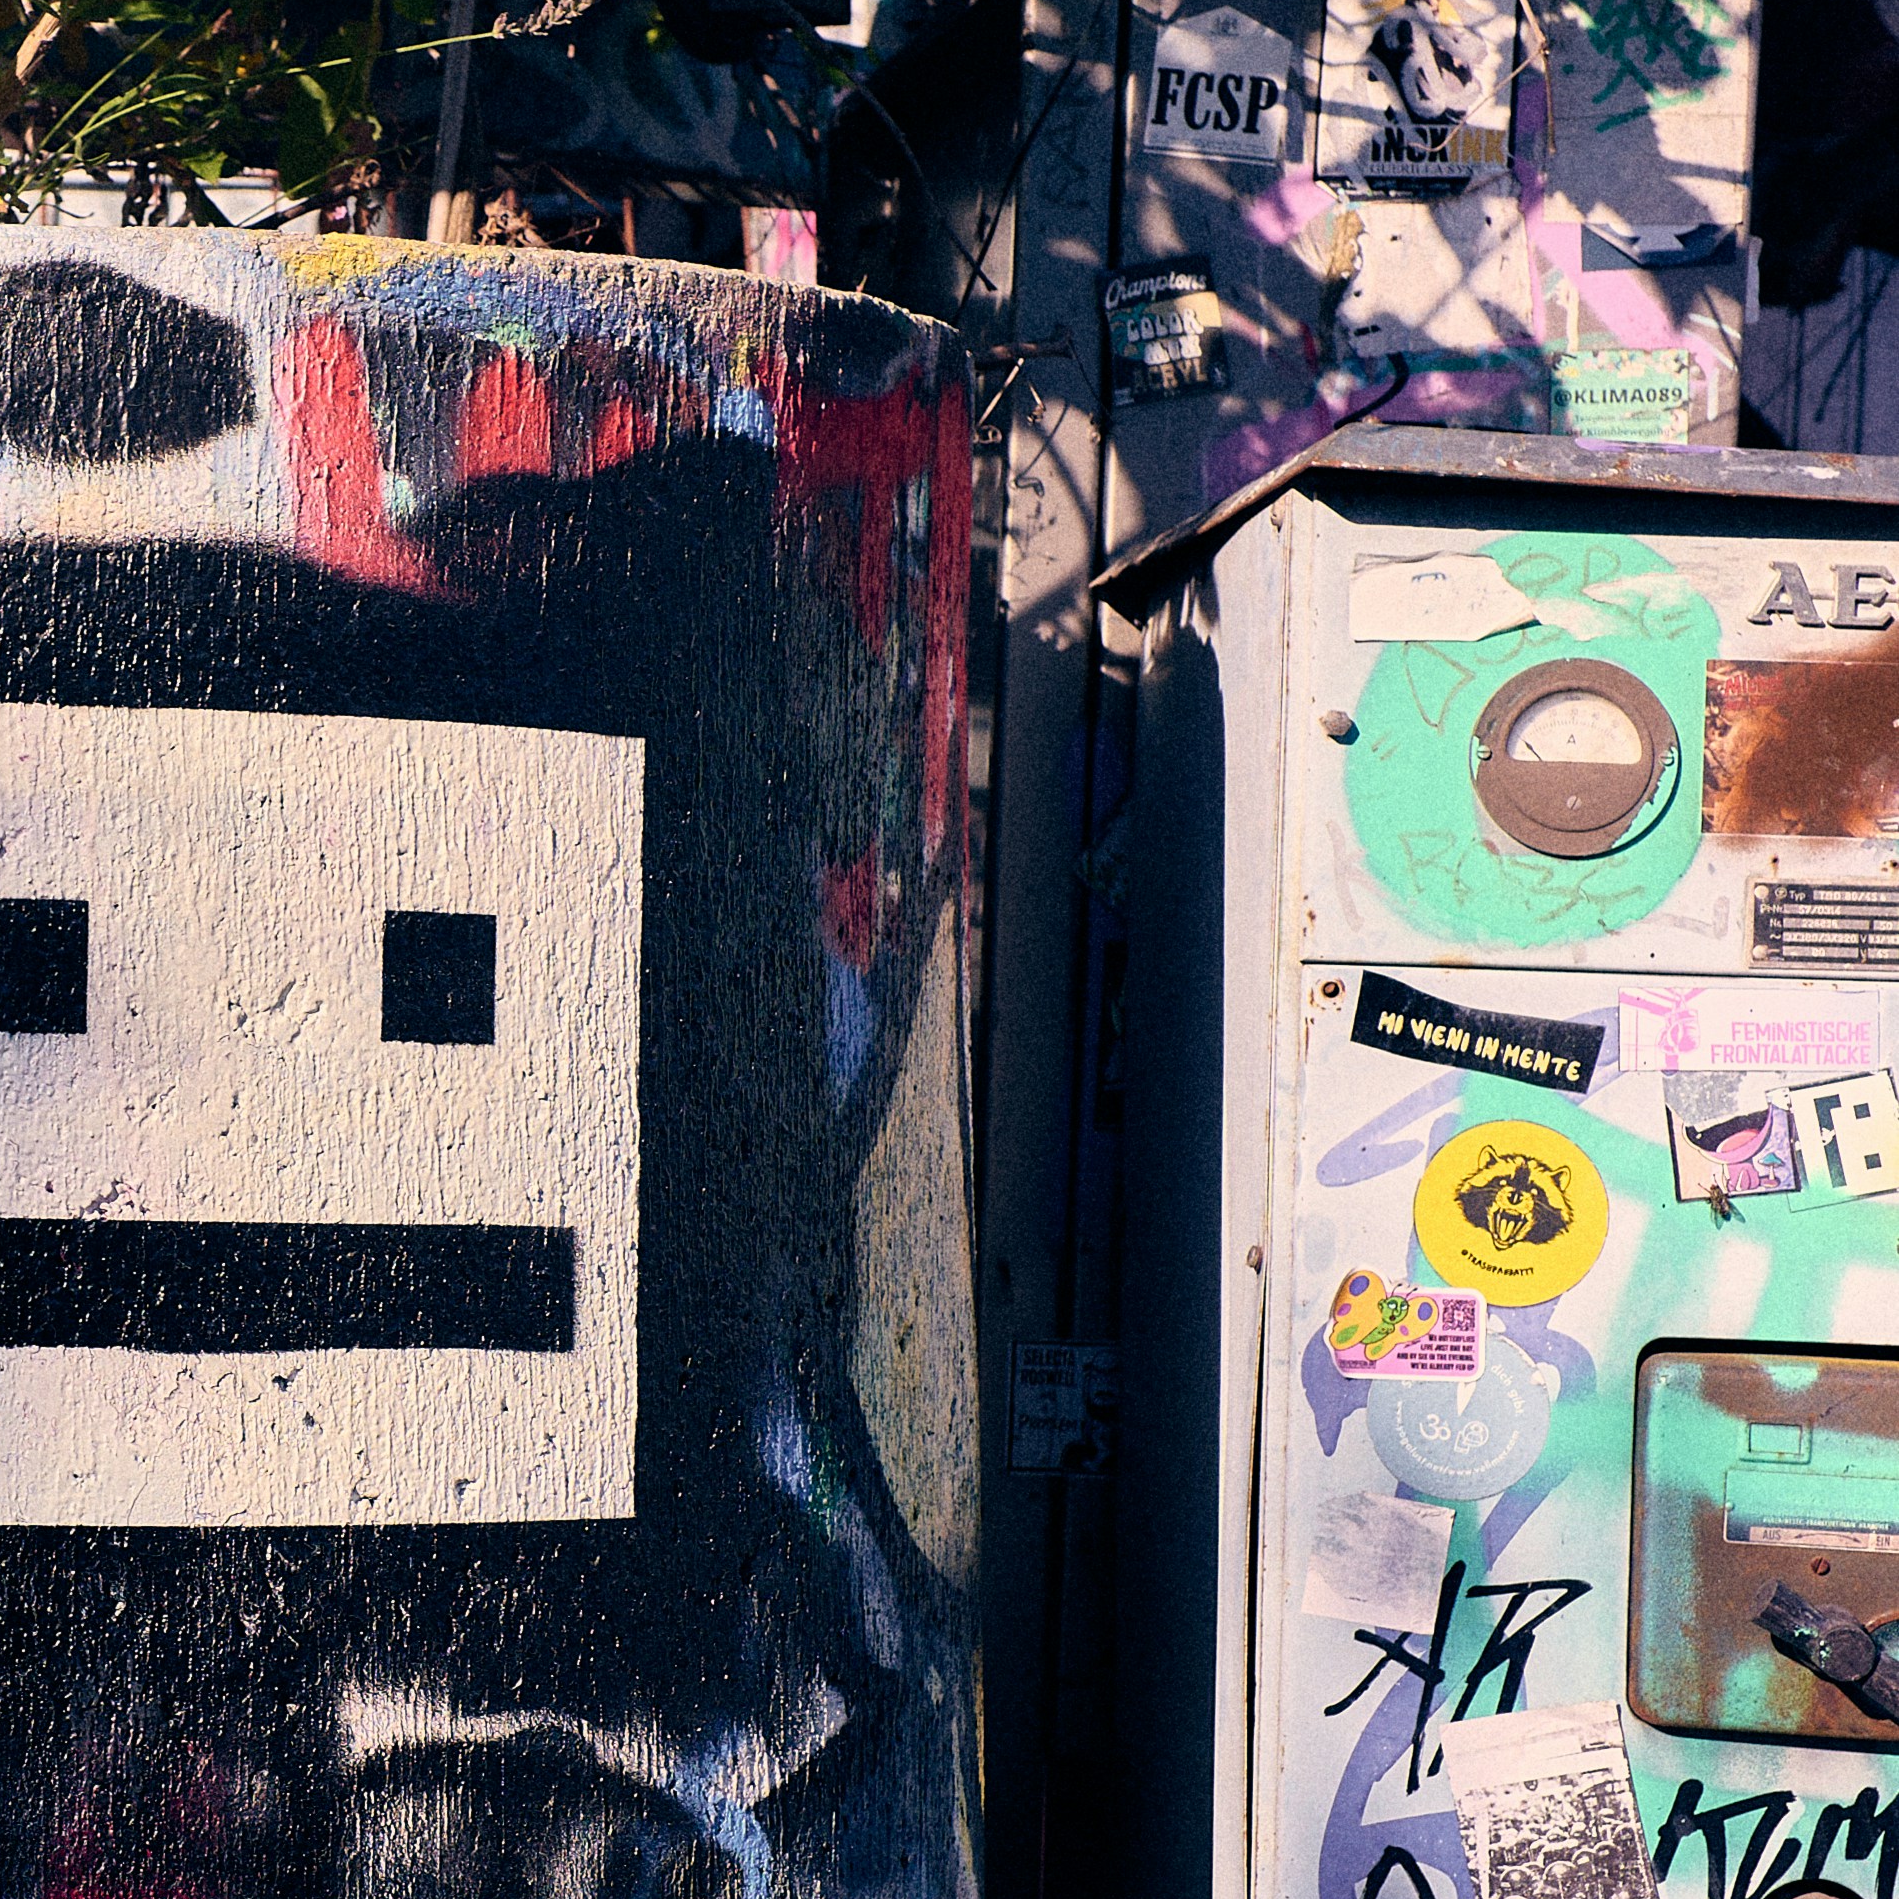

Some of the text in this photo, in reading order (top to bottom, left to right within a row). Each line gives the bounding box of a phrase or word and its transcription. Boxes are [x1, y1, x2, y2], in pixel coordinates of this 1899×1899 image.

[1151, 67, 1279, 134] FCSP
[1105, 270, 1208, 310] Champions
[1126, 308, 1205, 343] COLOR
[1554, 386, 1683, 408] @KLIMA089
[1566, 733, 1577, 745] A
[1789, 890, 1807, 902] Typ
[1377, 1011, 1582, 1083] MI VIENI IN MENTE
[1710, 1044, 1871, 1066] FRONTALATTACKE
[1439, 1334, 1475, 1343] BUTTERFLIES
[1420, 1343, 1434, 1351] LIVE
[1434, 1344, 1448, 1352] JUST
[1451, 1344, 1461, 1352] ONE
[1397, 1352, 1409, 1360] AND
[1436, 1353, 1448, 1361] THE
[1429, 1363, 1455, 1371] ALREADY
[1762, 1529, 1782, 1540] AUS
[1876, 1536, 1891, 1547] EIN
